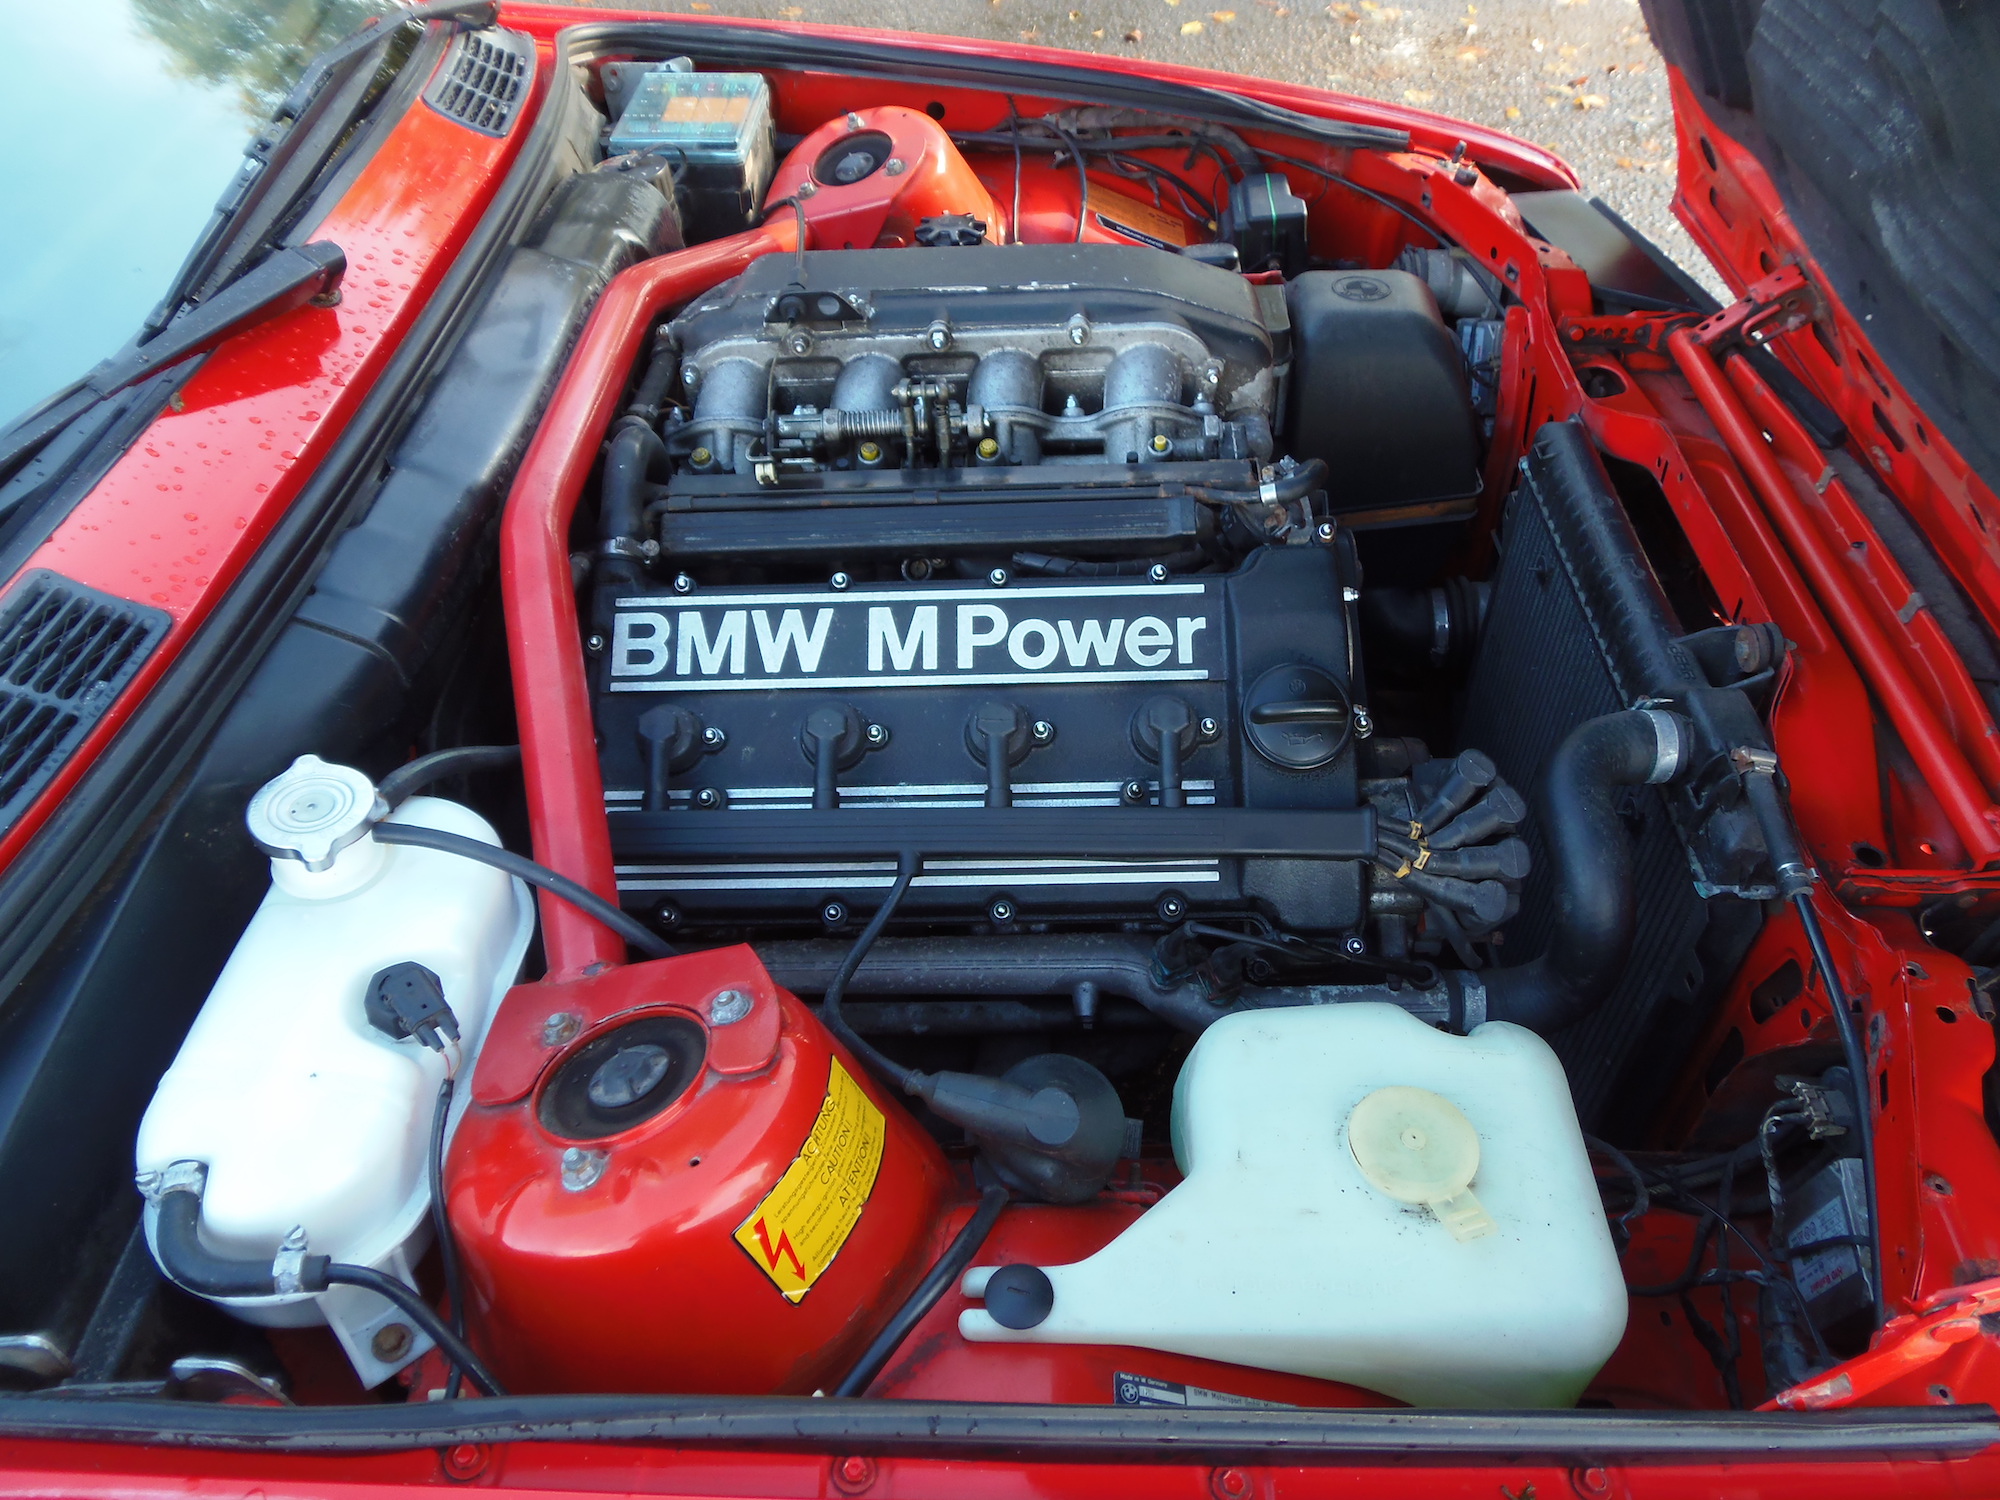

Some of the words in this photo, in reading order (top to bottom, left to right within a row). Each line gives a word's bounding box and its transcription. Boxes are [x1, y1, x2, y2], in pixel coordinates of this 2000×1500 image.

[610, 607, 834, 677] BMW
[867, 605, 938, 672] M
[956, 603, 1206, 670] Power
[803, 1099, 835, 1165] ACHTUNG
[820, 1119, 852, 1183] CAUTION!
